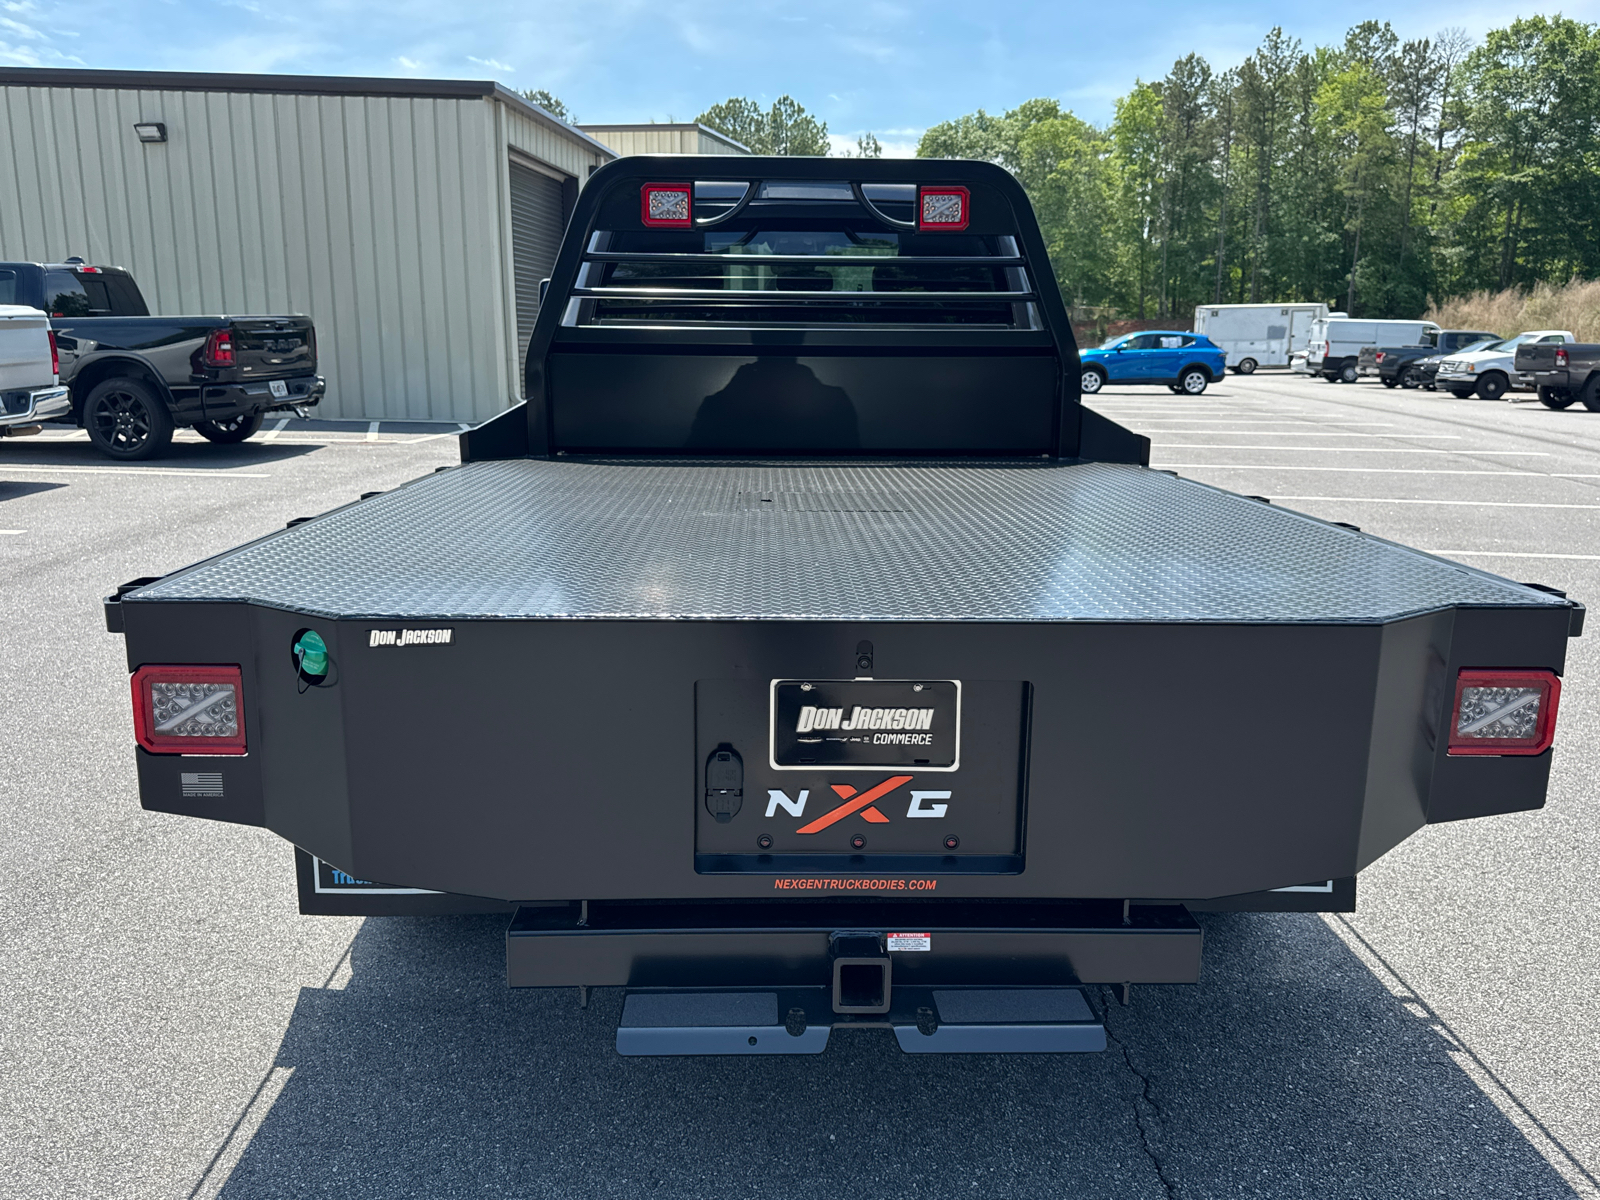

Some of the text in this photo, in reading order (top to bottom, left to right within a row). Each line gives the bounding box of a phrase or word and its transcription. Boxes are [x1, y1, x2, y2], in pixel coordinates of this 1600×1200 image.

[263, 338, 302, 351] RAM
[369, 628, 452, 648] DON JACKSON
[796, 706, 934, 733] DON JACKSON
[873, 733, 933, 745] COMMERCE
[764, 775, 952, 834] NXG
[774, 879, 937, 891] NEXGENTRUCKBODIES.COM
